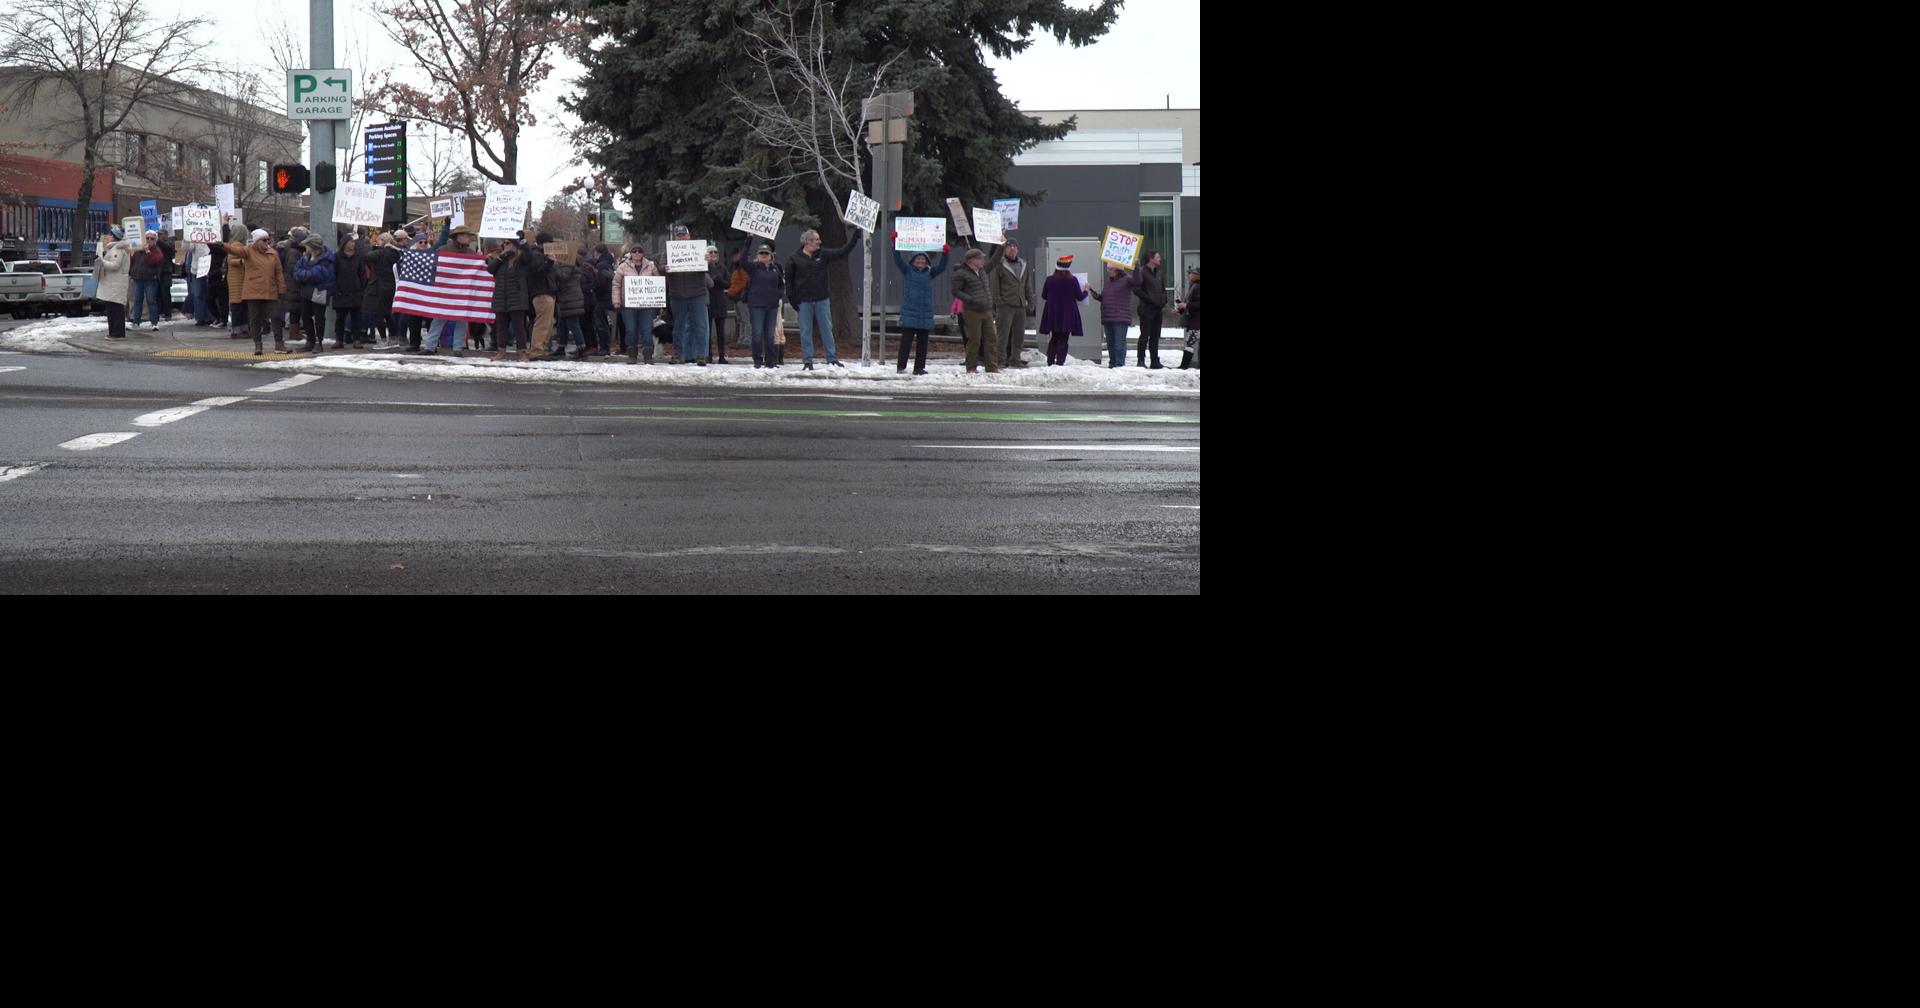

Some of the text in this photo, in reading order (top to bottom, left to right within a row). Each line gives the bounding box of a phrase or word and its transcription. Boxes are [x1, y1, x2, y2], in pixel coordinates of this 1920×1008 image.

[294, 74, 347, 103] PARKING
[295, 106, 343, 114] GARAGE
[743, 200, 779, 217] RESIST
[850, 201, 858, 212] IS
[740, 209, 781, 227] THE CRAZY
[190, 231, 217, 244] COUP
[1110, 231, 1138, 247] STOP
[1108, 240, 1130, 255] Truth
[1104, 249, 1133, 265] Decay!
[630, 277, 643, 286] Hell
